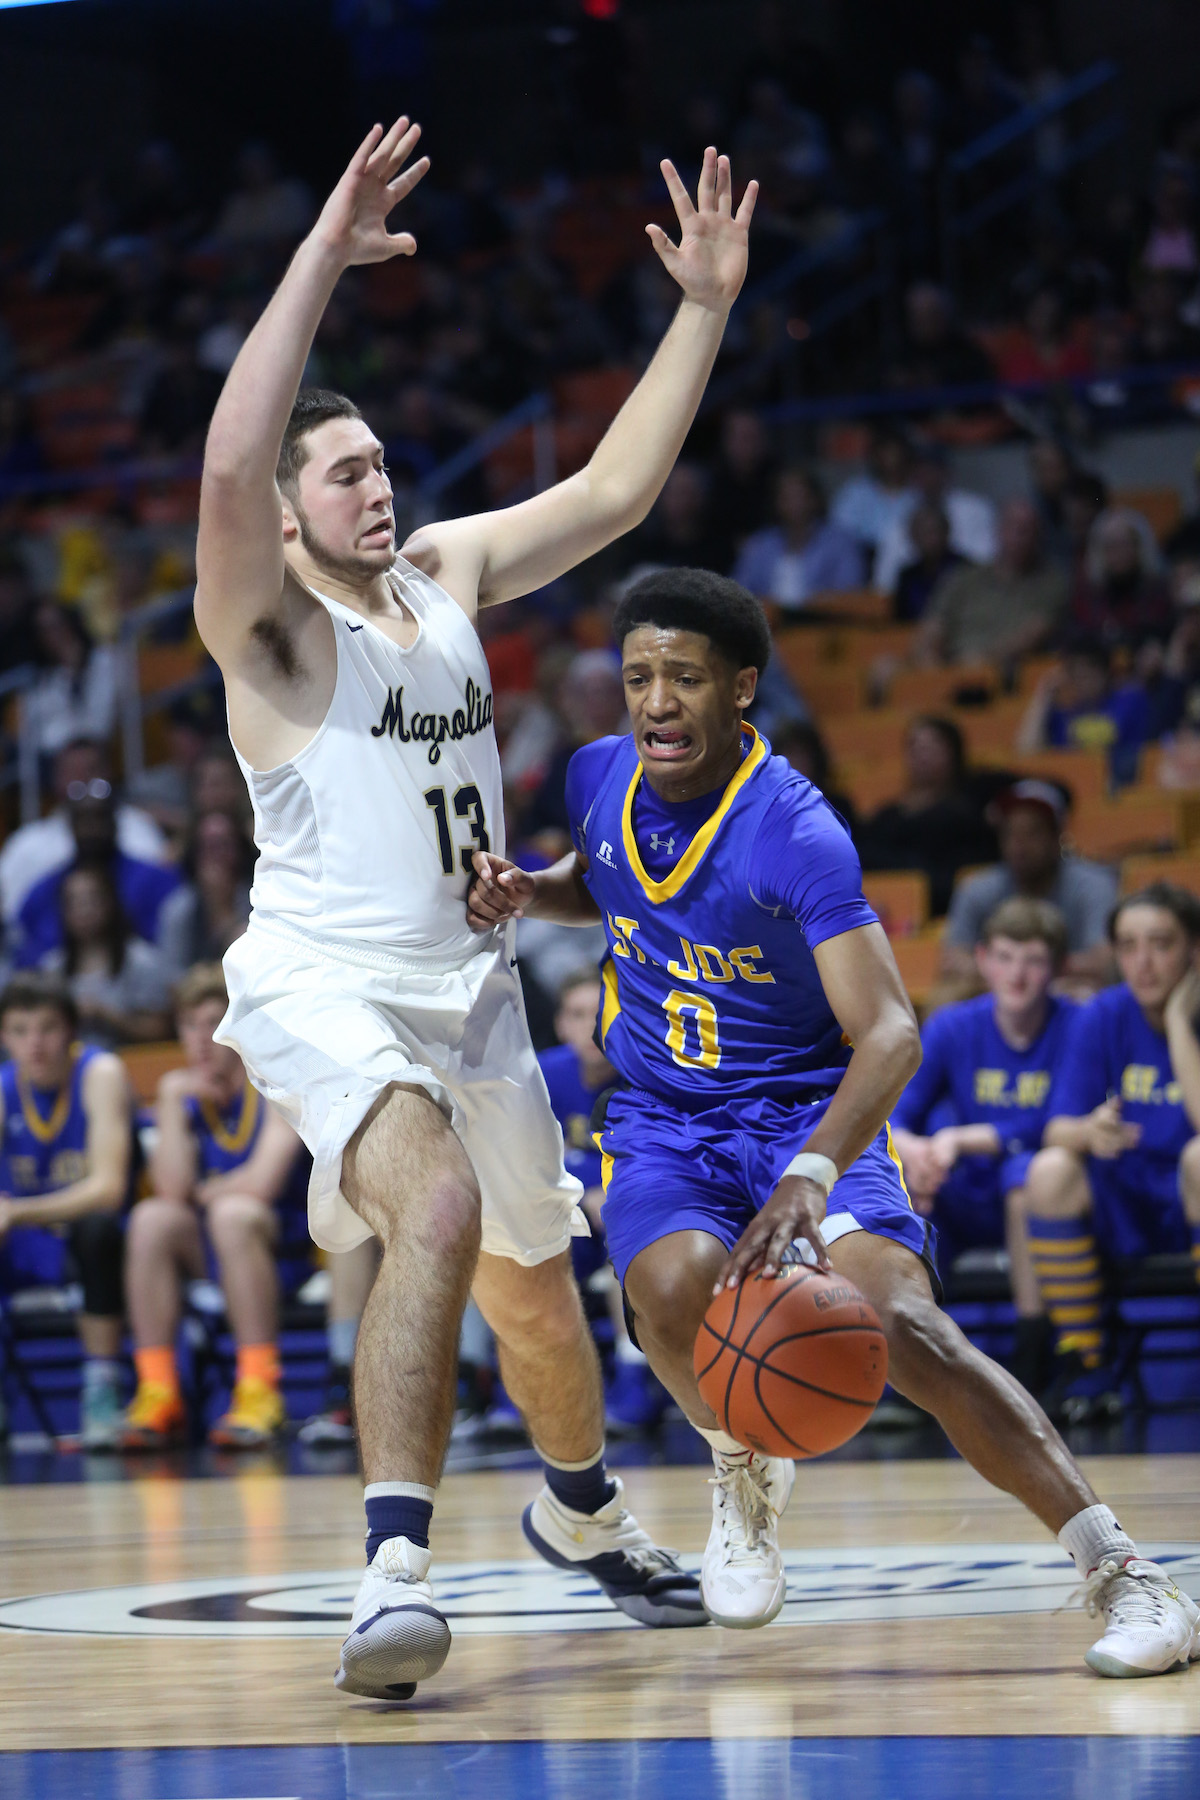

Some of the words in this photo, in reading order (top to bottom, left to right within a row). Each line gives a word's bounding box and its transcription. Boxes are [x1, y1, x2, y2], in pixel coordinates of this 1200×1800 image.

[371, 677, 494, 765] Magnolia
[422, 782, 490, 876] 13
[667, 936, 777, 984] JOE
[661, 989, 722, 1070] 0
